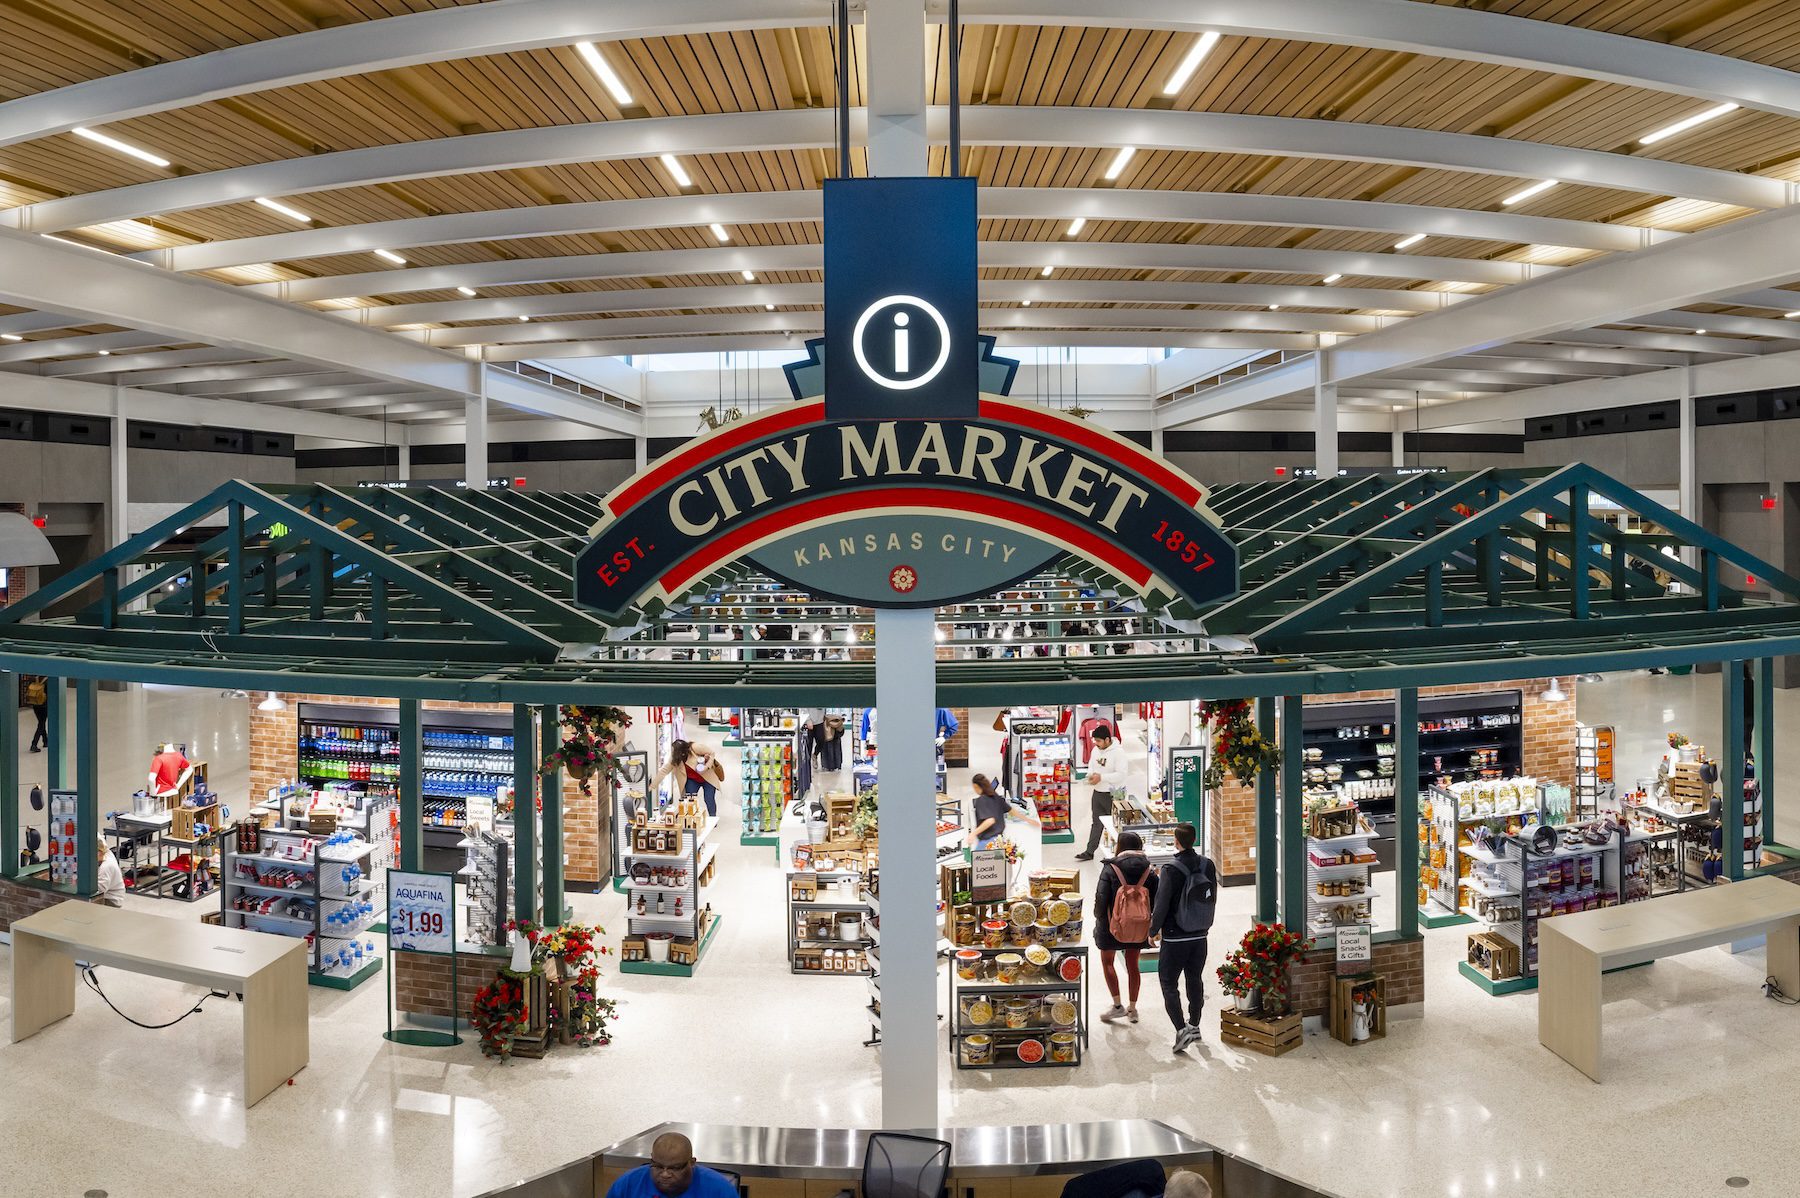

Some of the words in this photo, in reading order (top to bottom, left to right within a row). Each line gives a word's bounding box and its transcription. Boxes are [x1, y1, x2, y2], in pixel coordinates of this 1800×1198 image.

[668, 435, 810, 537] CITY
[838, 421, 1150, 534] MARKET
[595, 535, 656, 588] EST.
[793, 532, 925, 567] KANSAS
[941, 533, 1017, 565] CITY
[1150, 520, 1216, 574] 1857
[976, 865, 995, 873] Local
[396, 888, 444, 903] AQUAFINA
[399, 908, 443, 934] $1.99
